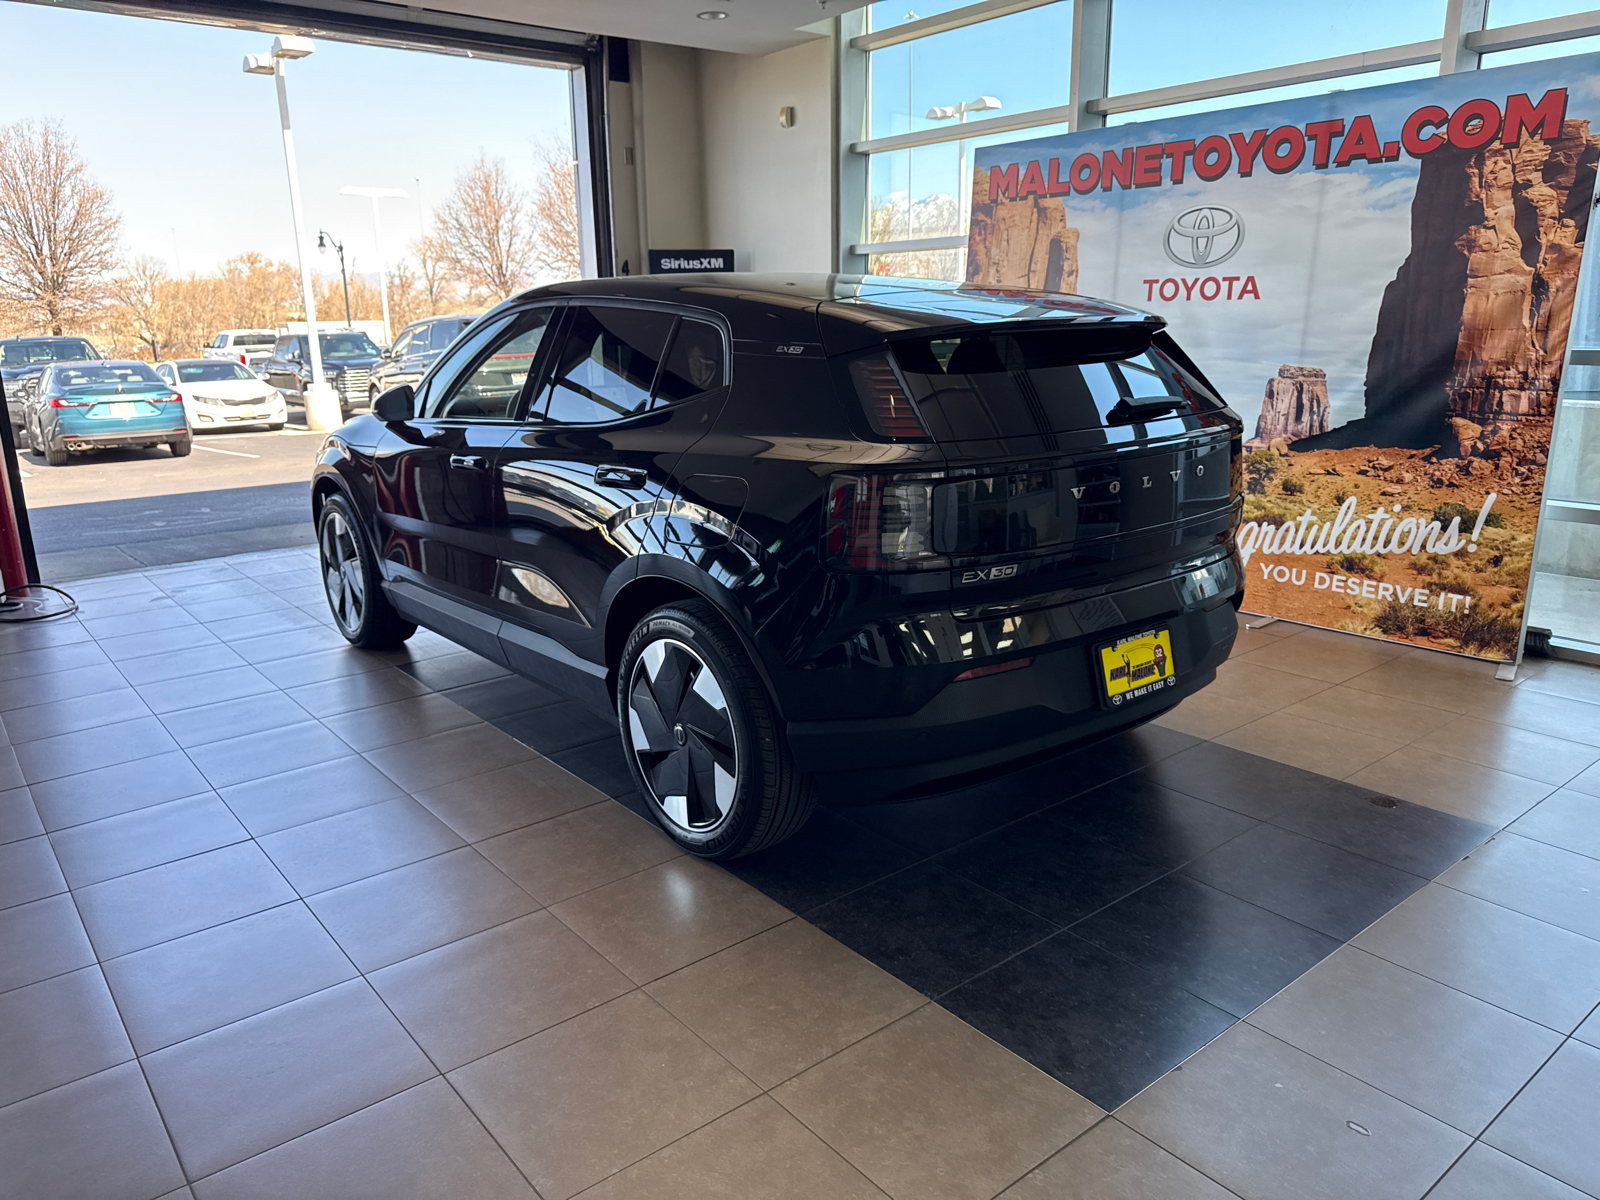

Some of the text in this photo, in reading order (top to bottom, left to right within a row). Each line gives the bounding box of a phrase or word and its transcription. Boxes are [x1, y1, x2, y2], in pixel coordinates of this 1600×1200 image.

[989, 87, 1568, 201] MALONETOYOTA.COM
[661, 258, 724, 269] SiriusXM
[1143, 276, 1261, 302] TOYOTA
[1071, 465, 1205, 499] VOLVO
[1237, 492, 1497, 567] gratulations!
[962, 564, 1018, 583] EX30
[1260, 563, 1471, 614] YOU DESERVE IT!
[620, 624, 649, 677] MICHELIN
[1155, 649, 1163, 658] 32
[1131, 663, 1155, 682] MALONE
[1125, 680, 1164, 700] WE MAKE IT EASY
